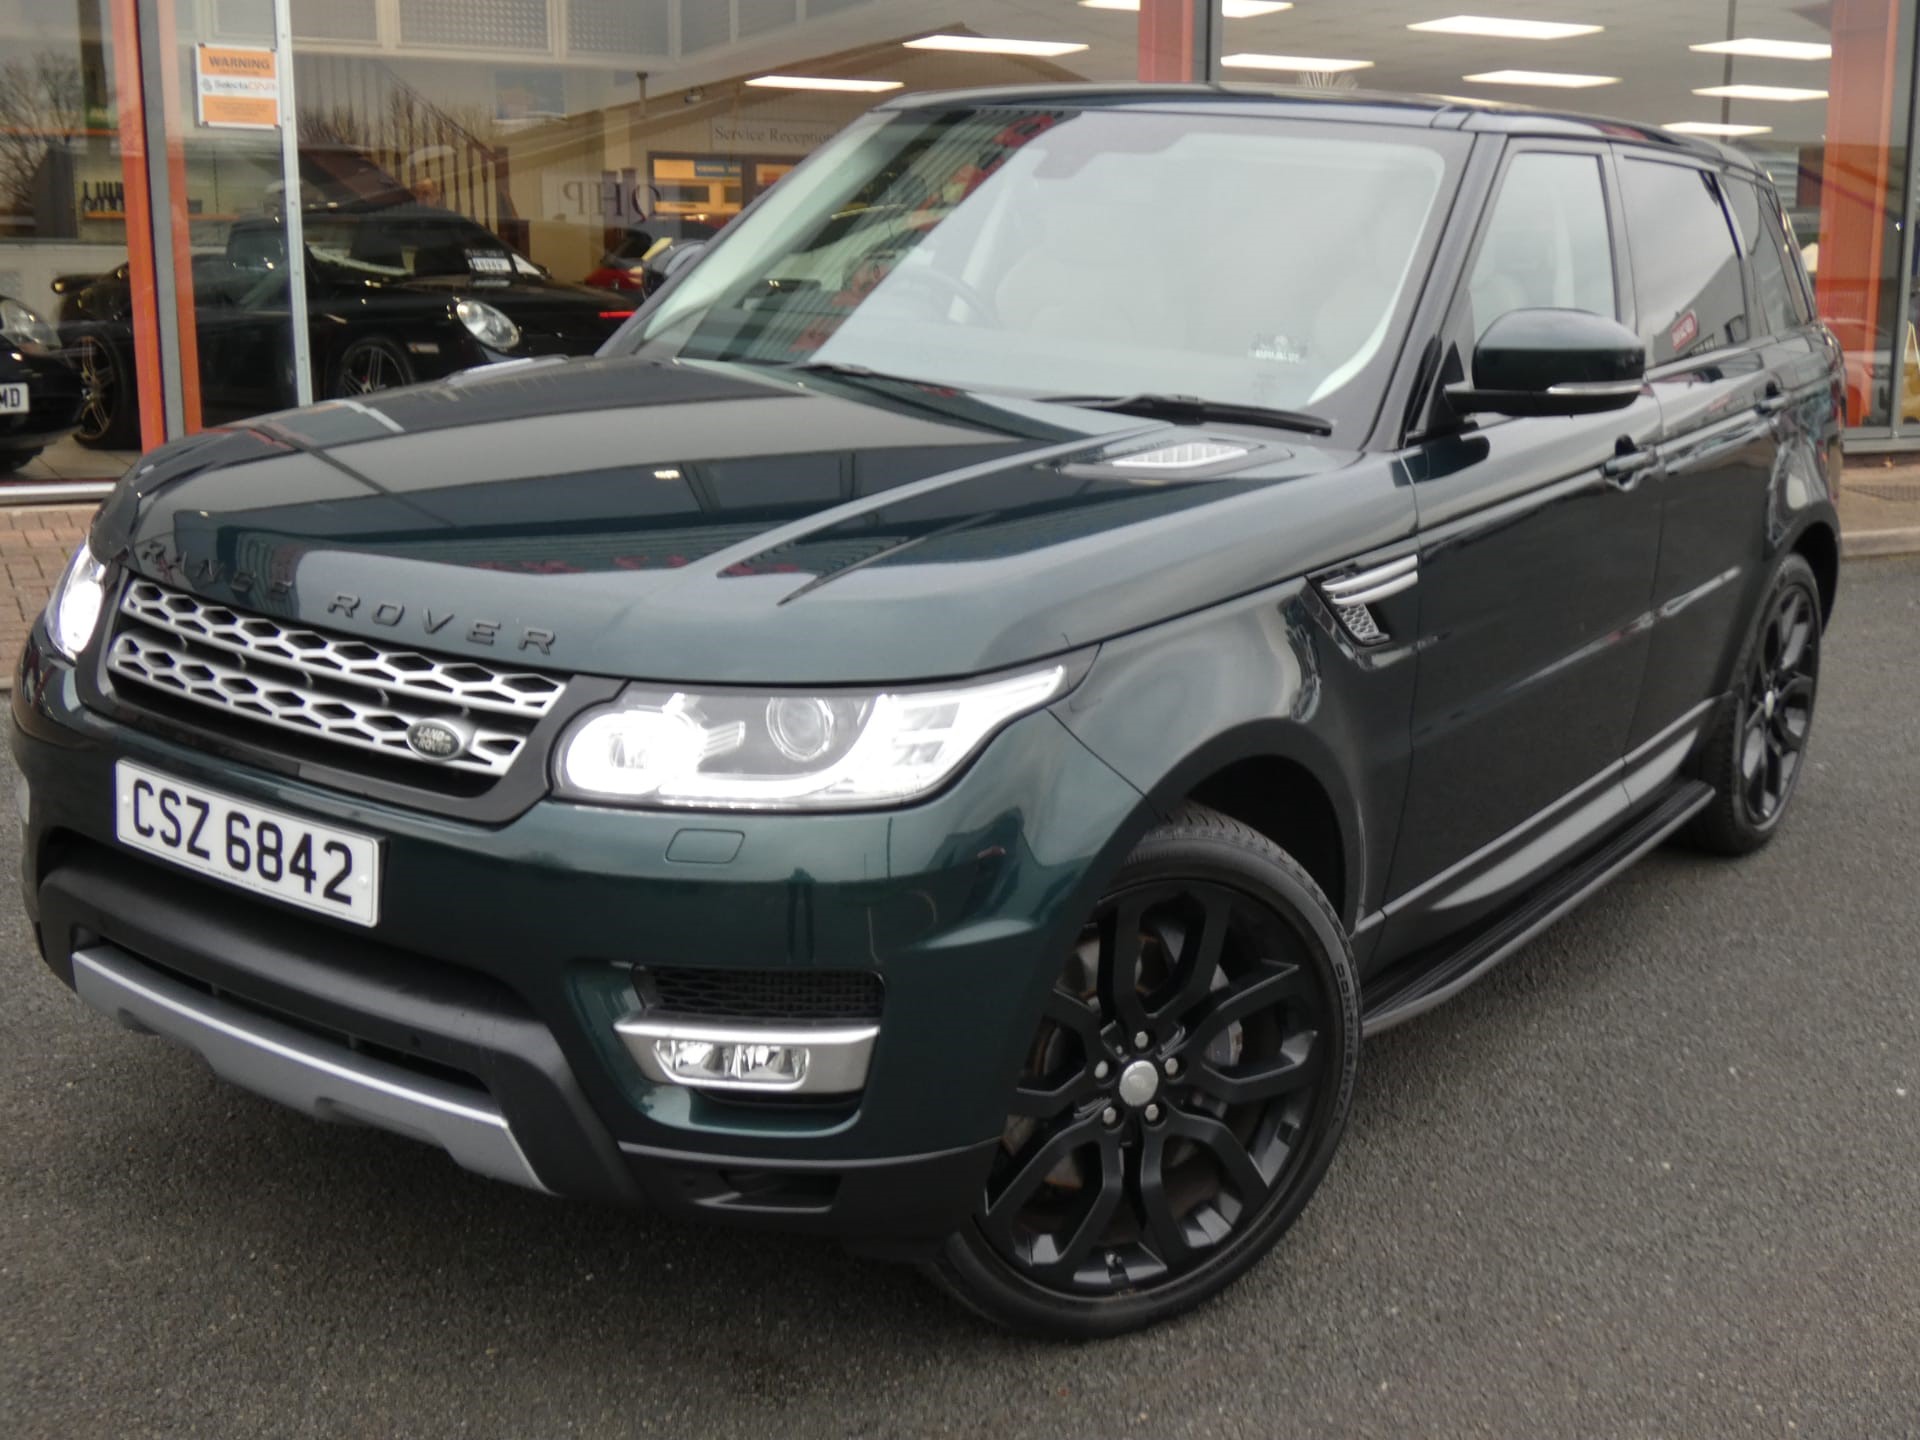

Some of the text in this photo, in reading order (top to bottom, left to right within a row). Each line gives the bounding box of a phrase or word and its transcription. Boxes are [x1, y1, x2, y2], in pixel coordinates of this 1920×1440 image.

[209, 55, 271, 70] WARNING
[714, 127, 765, 142] Service
[327, 592, 556, 656] ROVER
[417, 726, 446, 741] LAND
[417, 739, 451, 753] ROVER
[133, 778, 353, 906] CSZ 6842
